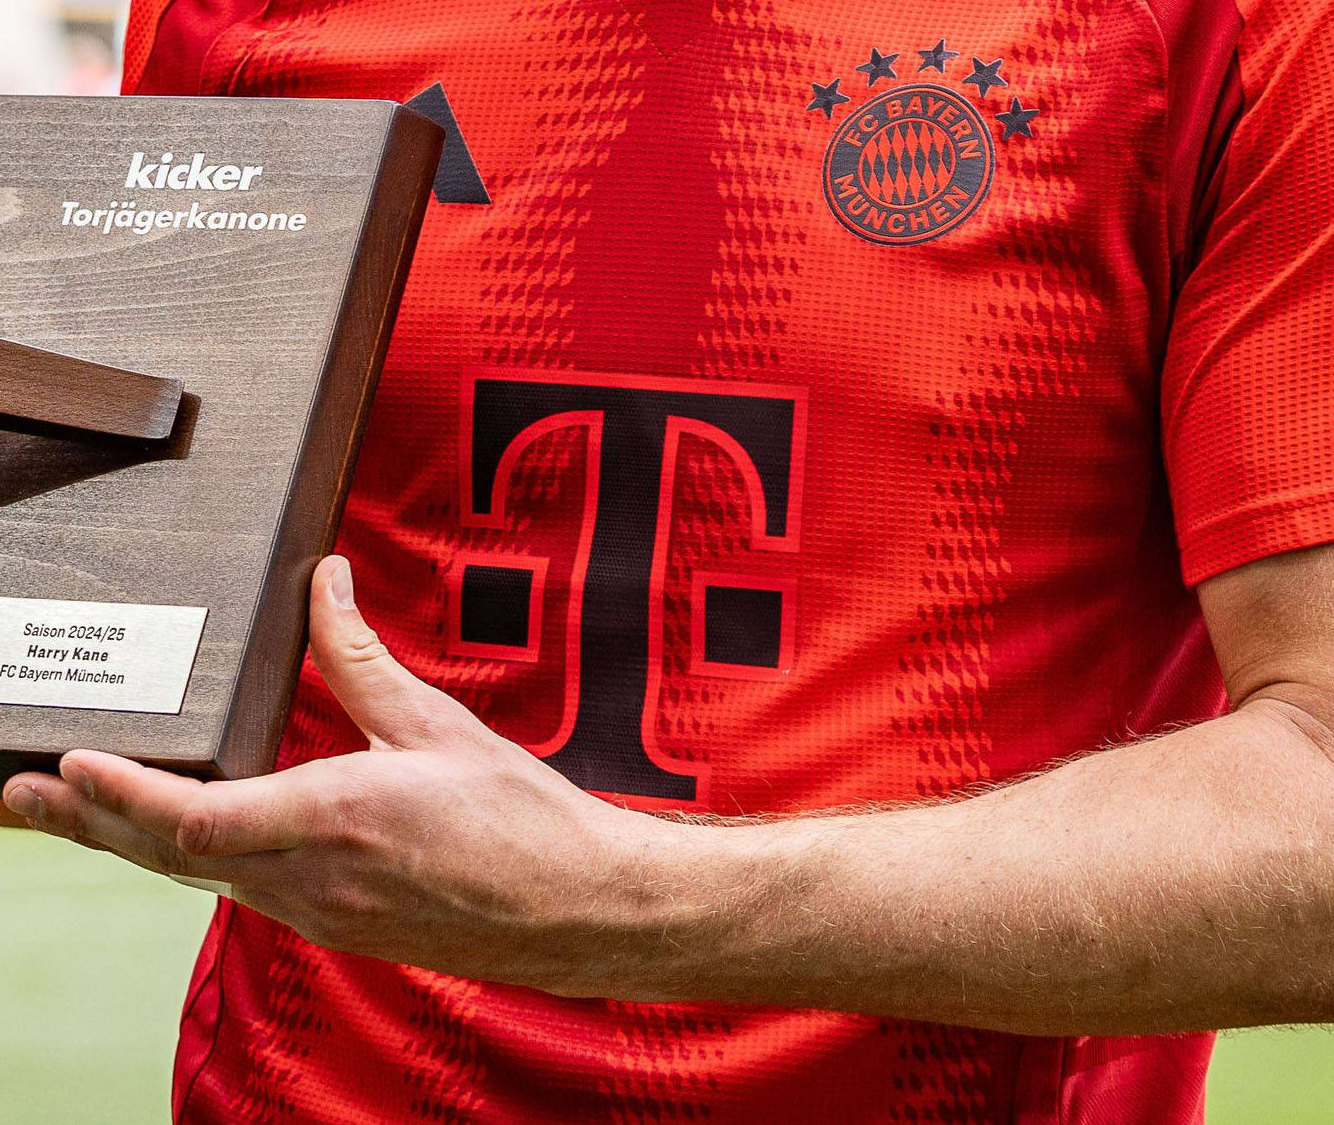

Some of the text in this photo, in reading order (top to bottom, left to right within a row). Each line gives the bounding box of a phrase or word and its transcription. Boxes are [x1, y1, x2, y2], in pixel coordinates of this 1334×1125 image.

[844, 96, 981, 160] FC BAYERN
[124, 151, 264, 191] kicker
[61, 201, 307, 235] Torjägerkanone
[23, 623, 126, 642] Saison 2024/25
[27, 645, 109, 663] Harry Kane
[0, 664, 125, 684] FC Bayern München
